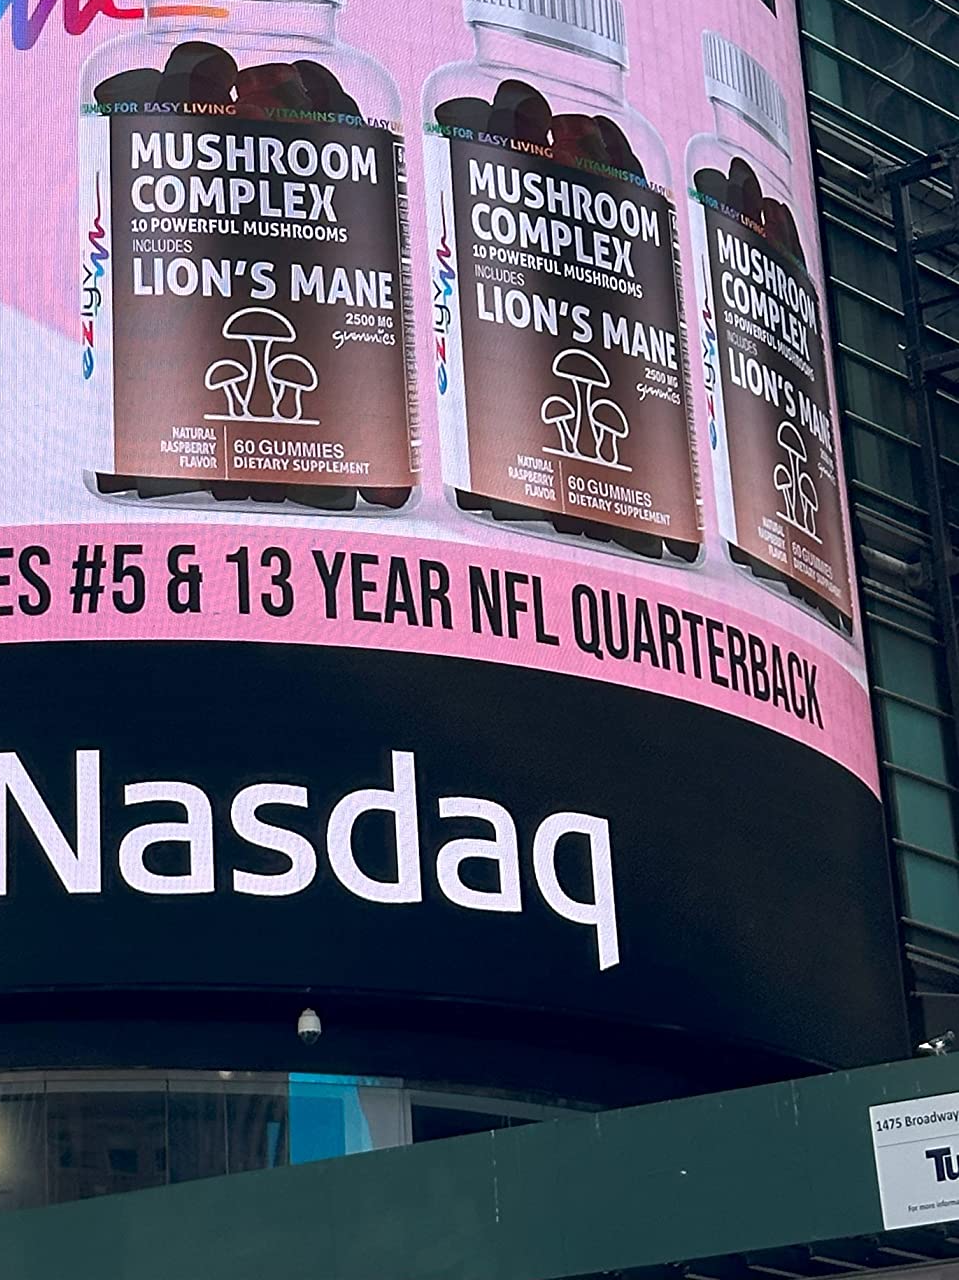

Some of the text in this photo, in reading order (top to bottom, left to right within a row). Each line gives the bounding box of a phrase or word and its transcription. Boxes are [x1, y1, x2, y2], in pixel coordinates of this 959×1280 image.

[114, 102, 138, 113] FOR
[144, 102, 180, 113] EASY
[183, 102, 237, 115] LIVING
[264, 107, 336, 123] VITAMINS
[338, 114, 363, 126] FOR
[453, 126, 473, 140] FOR
[478, 131, 509, 146] EASY
[510, 139, 554, 158] LIVING
[130, 132, 378, 184] MUSHROOM
[130, 175, 338, 222] COMPLEX
[469, 159, 661, 247] MUSHROOM
[131, 218, 348, 243] 10 POWERFUL MUSHROOMS
[471, 202, 636, 278] COMPLEX
[132, 239, 193, 254] INCLUDES
[132, 256, 394, 310] LION'S MANE
[472, 244, 644, 299] 10 POWERFUL MUSHROOMS
[474, 263, 525, 287] INCLUDES
[716, 228, 818, 334] MUSHROOM
[345, 312, 375, 326] 2500
[721, 271, 811, 362] COMPLEX
[332, 328, 396, 350] gummies
[602, 312, 678, 370] MANE
[734, 313, 778, 350] POWERFUL
[172, 426, 217, 440] NATURAL
[160, 440, 216, 455] RASPBERRY
[234, 439, 344, 460] 60 GUMMIES
[179, 455, 217, 469] FLAVOR
[234, 456, 370, 475] DIETARY SUPPLEMENT
[517, 454, 554, 473] NATURAL
[525, 483, 556, 501] FLAVOR
[567, 475, 652, 508] 60 GUMMIES
[568, 491, 671, 526] DIETARY SUPPLEMENT
[70, 543, 146, 615] #5
[166, 543, 203, 614] &
[226, 545, 295, 618] 13
[311, 549, 454, 631] YEAR
[468, 564, 560, 647] NFL
[570, 582, 827, 730] QUARTERBACK
[876, 1110, 959, 1132] 1475 Broadway
